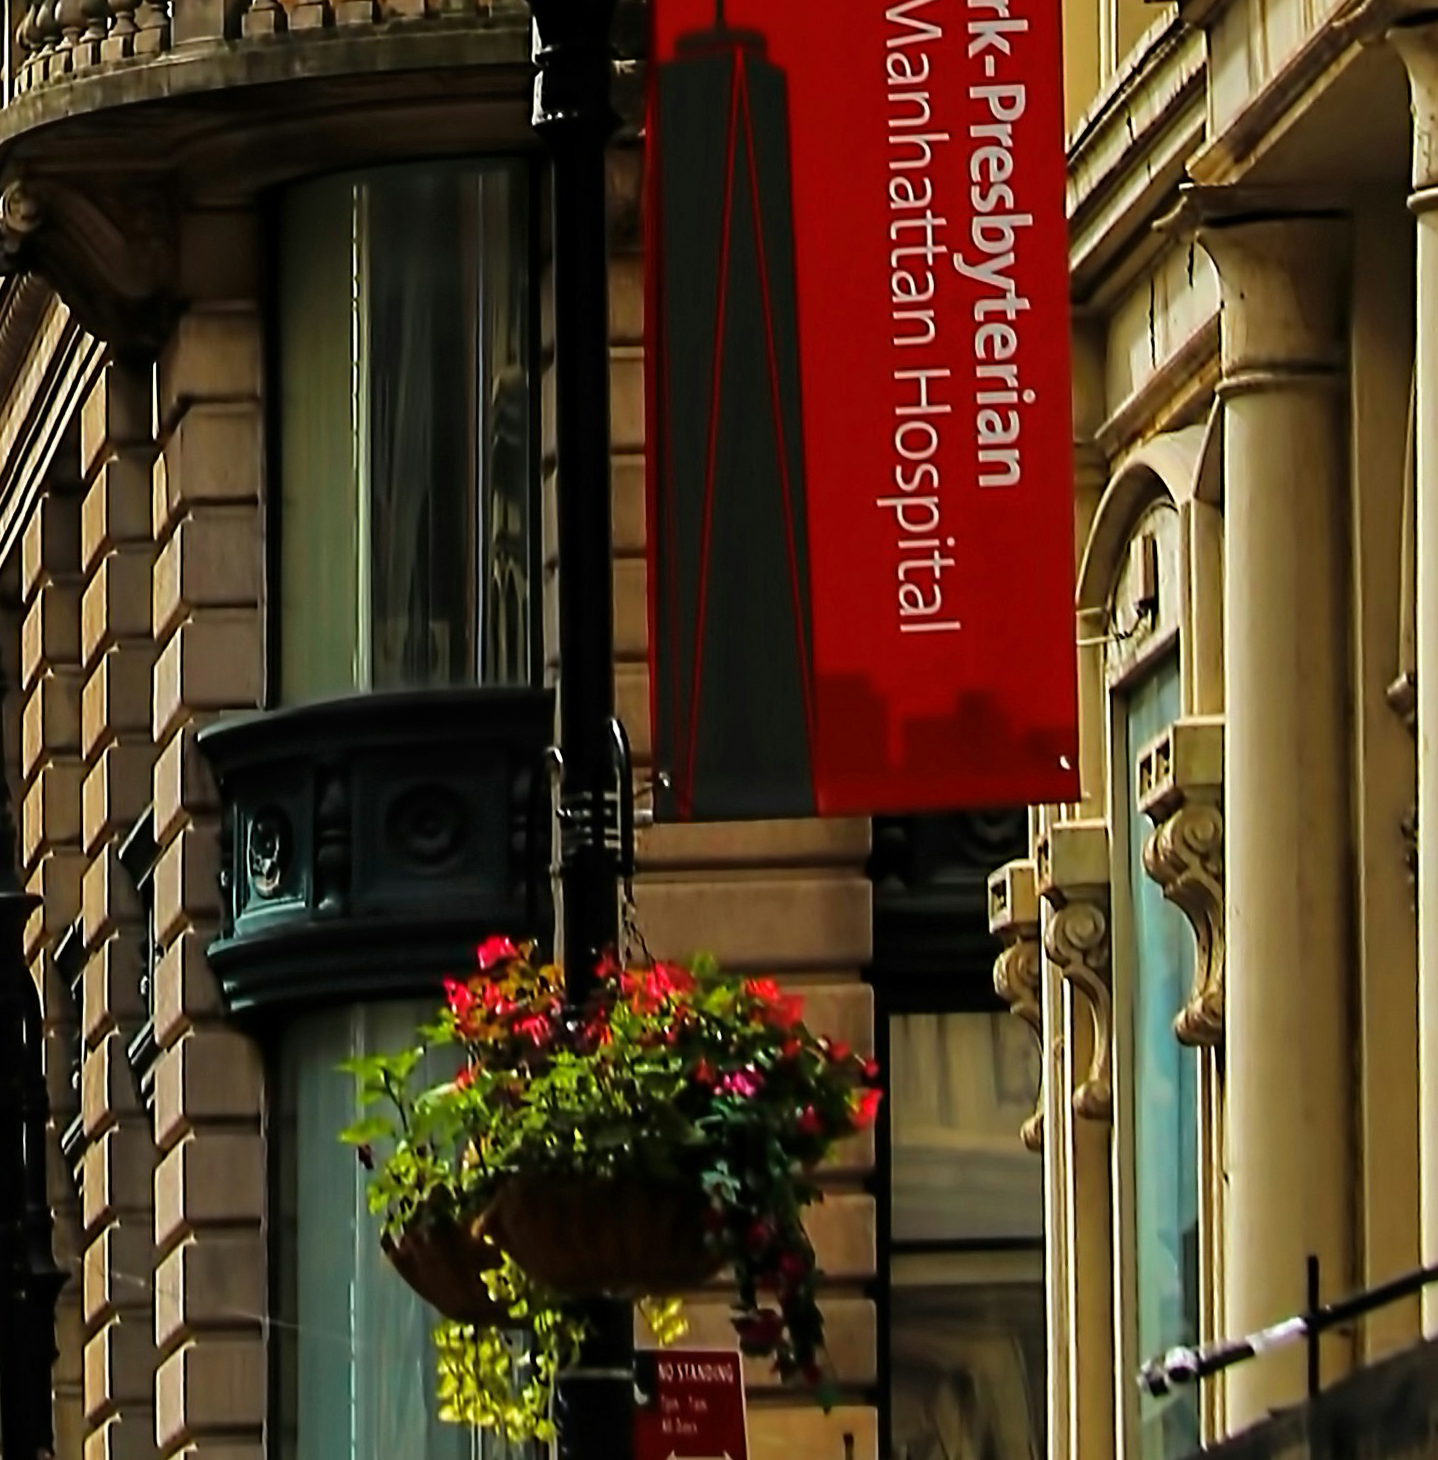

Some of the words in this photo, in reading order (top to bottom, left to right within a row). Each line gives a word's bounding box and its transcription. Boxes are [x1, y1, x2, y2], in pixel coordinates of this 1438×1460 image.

[876, 369, 961, 632] Hospital
[658, 1363, 674, 1382] NO
[677, 1363, 733, 1383] STANDING
